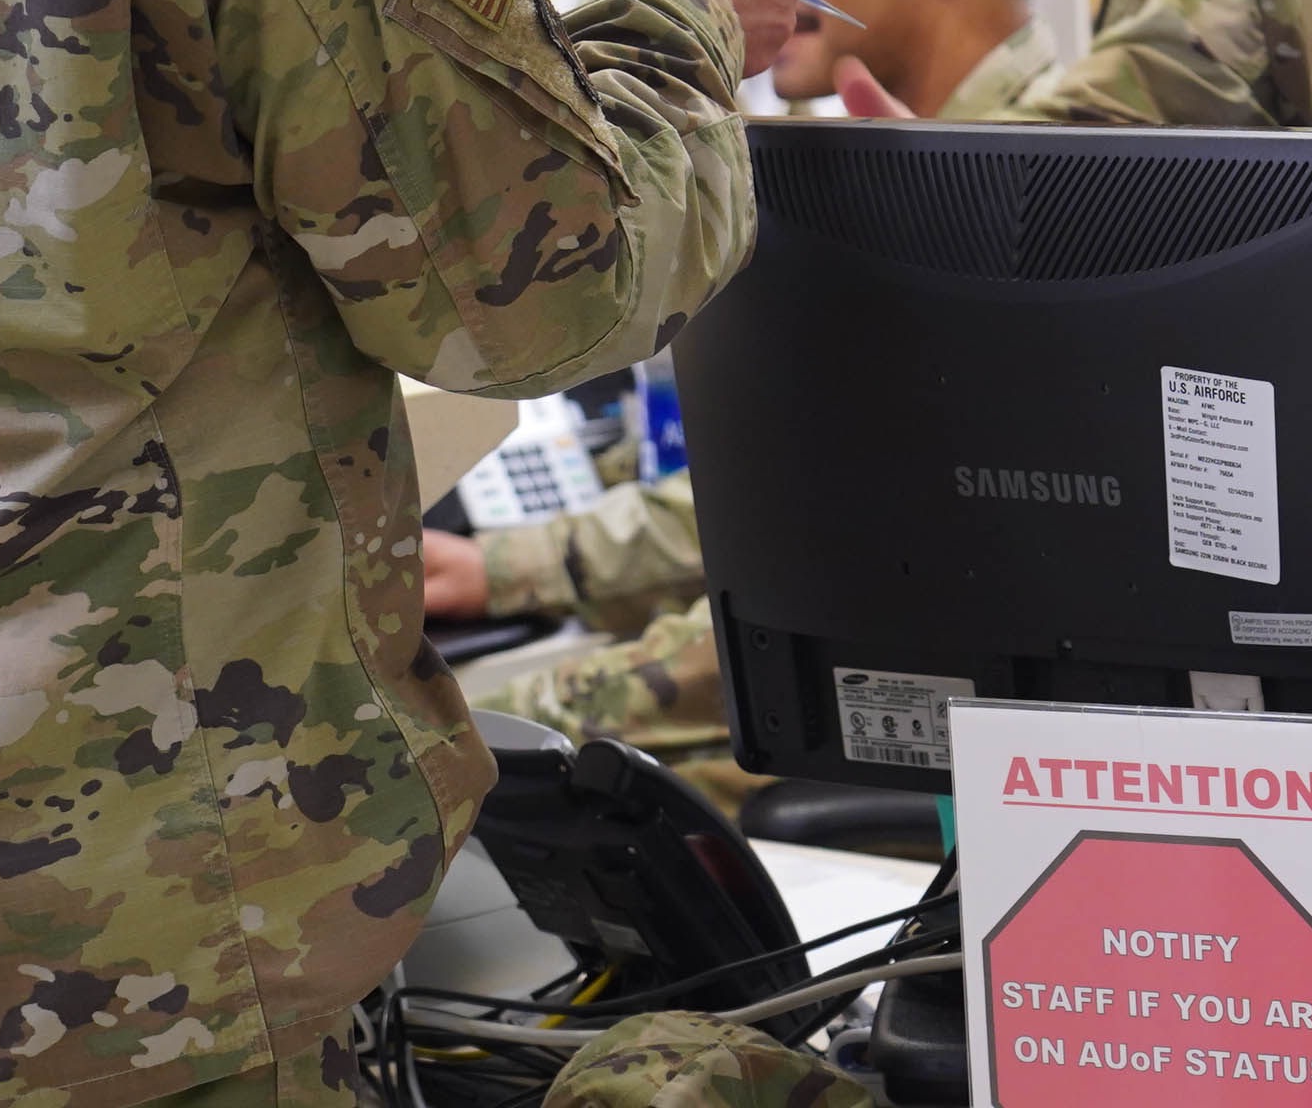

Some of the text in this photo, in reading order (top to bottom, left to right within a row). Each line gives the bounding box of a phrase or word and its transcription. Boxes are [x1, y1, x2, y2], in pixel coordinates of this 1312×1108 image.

[1169, 380, 1246, 404] U.S. AIRFORCE
[1174, 372, 1239, 390] PROPERTY OF THE
[954, 466, 1122, 507] SAMSUNG
[1102, 928, 1240, 963] NOTIFY
[1002, 980, 1114, 1015] STAFF
[1128, 990, 1160, 1018] IF
[1172, 993, 1251, 1025] YOU
[1013, 1035, 1066, 1065] ON
[1078, 1040, 1172, 1073] AUoF
